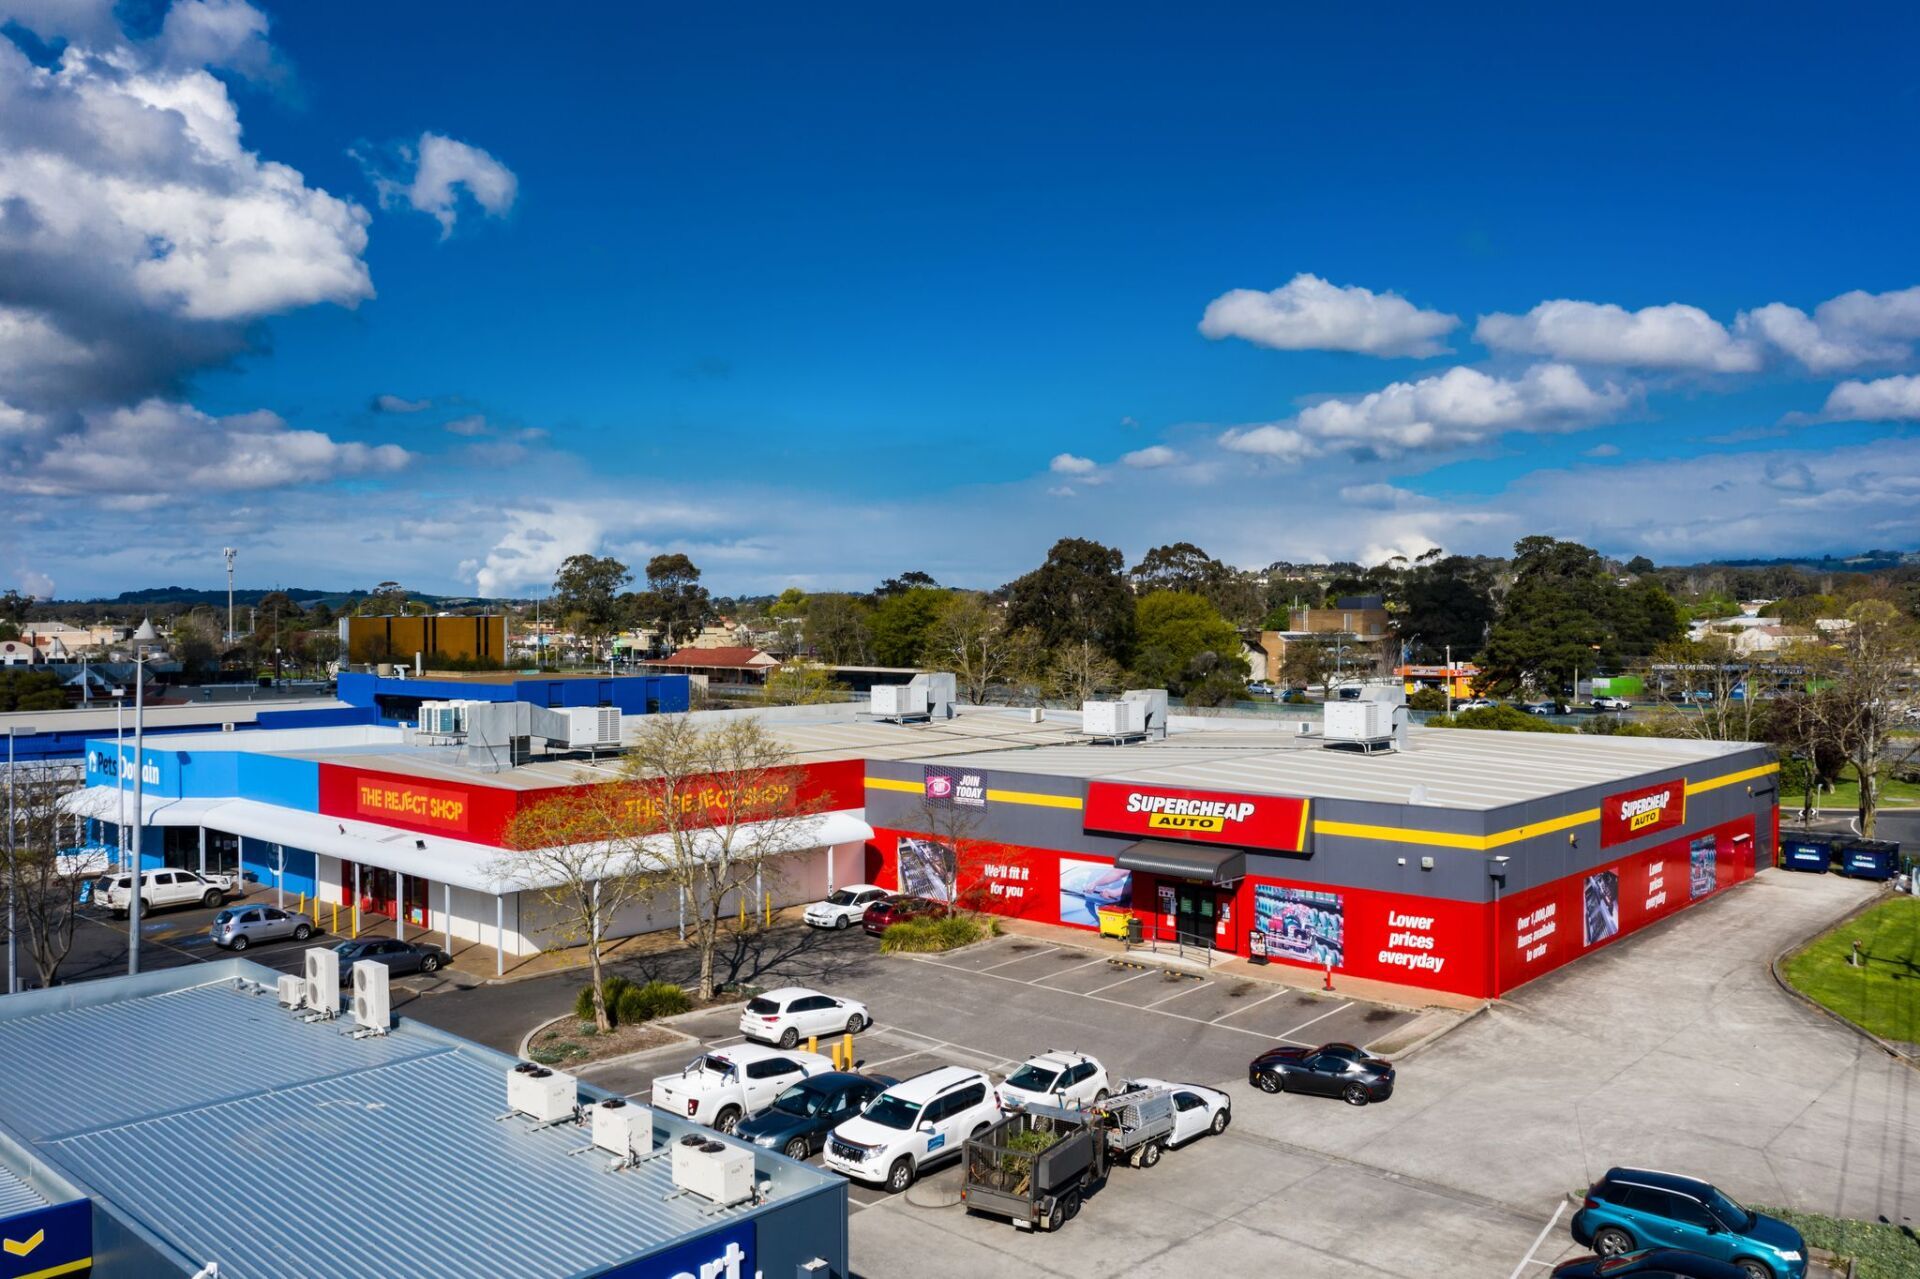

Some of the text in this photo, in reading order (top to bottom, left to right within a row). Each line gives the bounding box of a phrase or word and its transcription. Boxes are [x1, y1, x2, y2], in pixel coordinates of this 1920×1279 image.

[98, 751, 160, 785] Pets Doain
[959, 774, 980, 786] JOIN
[956, 785, 984, 798] TODAY
[361, 786, 463, 821] THE REJECT SHOP
[1126, 792, 1255, 823] SUPERCHEAP
[1620, 790, 1670, 821] SUPERCHEAP
[1158, 817, 1214, 828] AUTO
[1634, 812, 1656, 826] AUTO
[984, 864, 1030, 880] We'll fit it
[1649, 861, 1664, 876] Lower
[990, 881, 1024, 899] for you
[1388, 910, 1435, 930] Lower
[1517, 916, 1531, 931] Over
[1388, 931, 1435, 950] prices
[1517, 933, 1533, 949] items
[1526, 943, 1548, 962] to order
[1378, 950, 1445, 974] everyday
